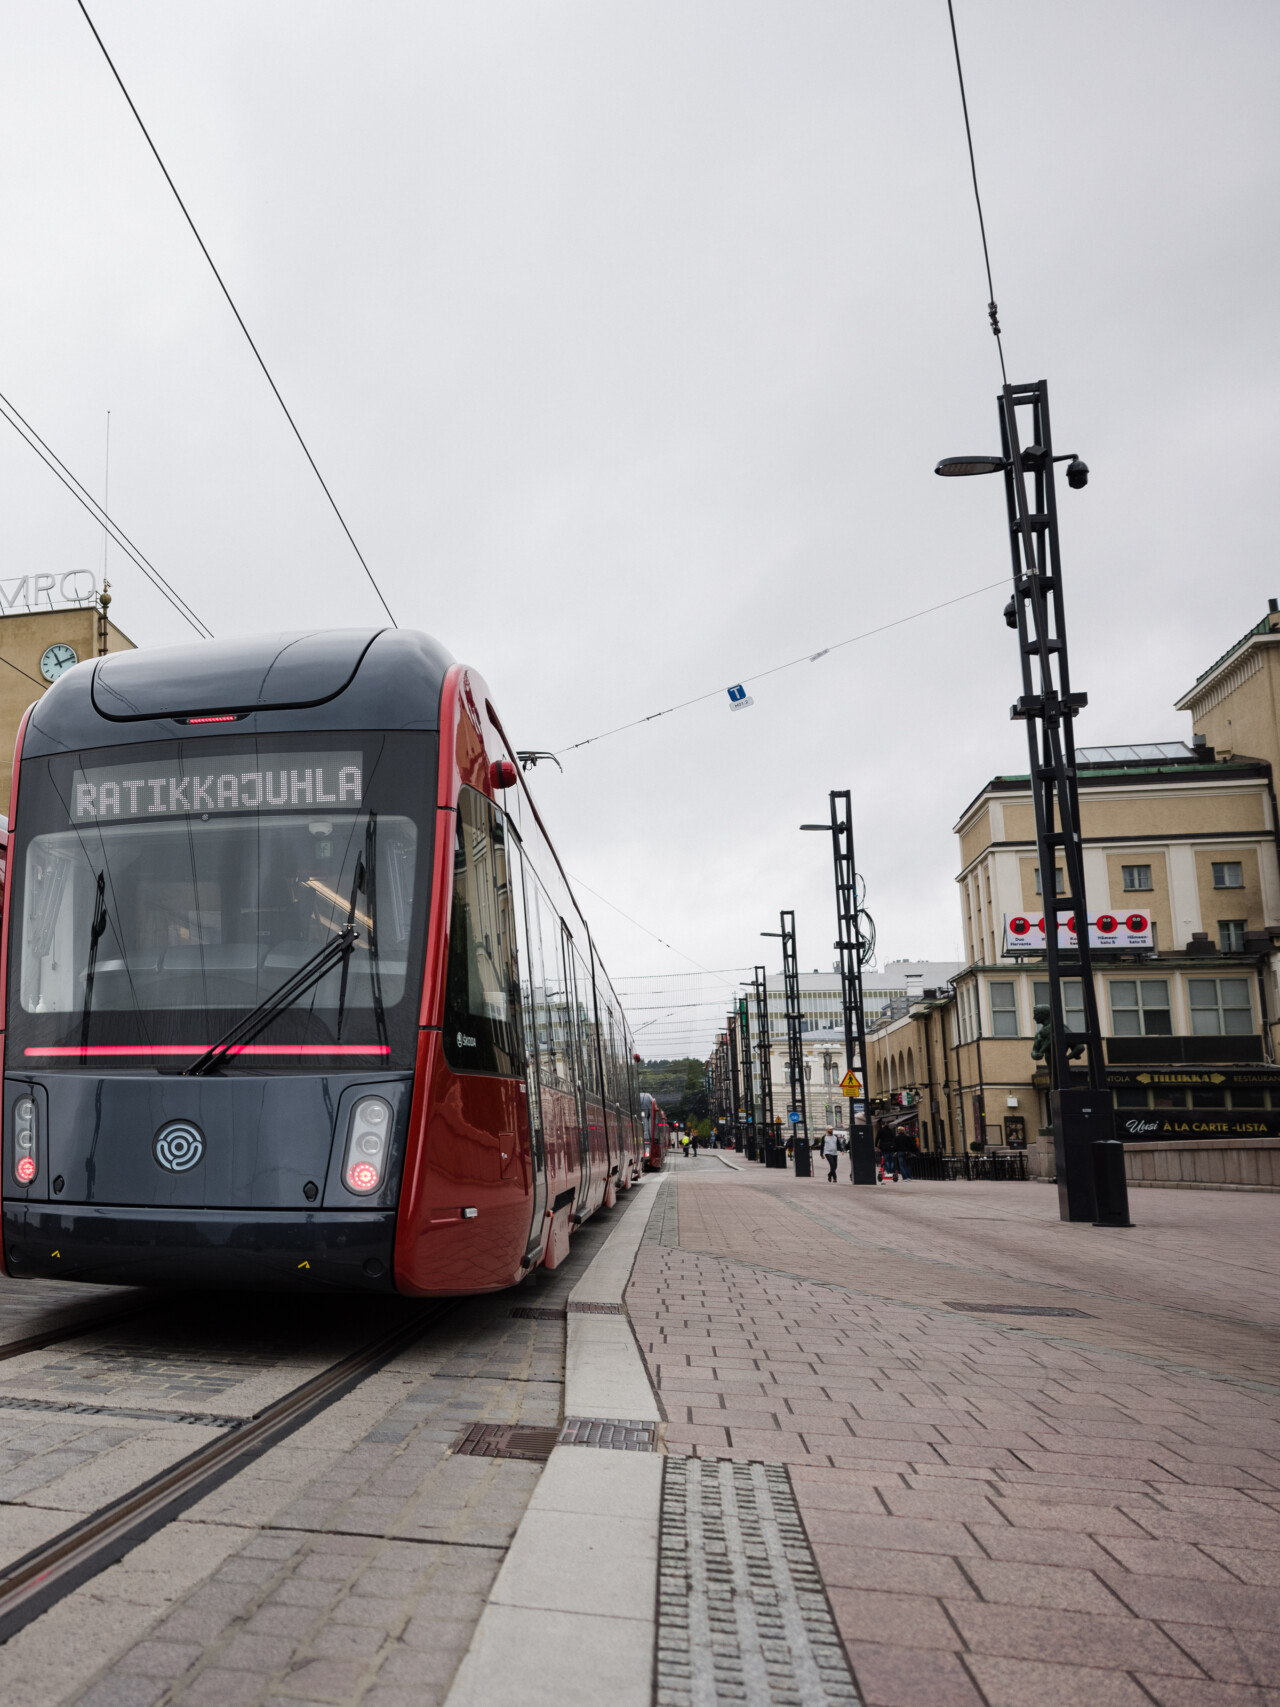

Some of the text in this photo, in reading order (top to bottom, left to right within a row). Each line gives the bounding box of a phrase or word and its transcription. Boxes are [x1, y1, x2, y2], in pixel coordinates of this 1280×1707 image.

[730, 686, 740, 699] T
[76, 766, 362, 816] RATIKKAJUHLA
[1153, 1074, 1210, 1083] TILLIKKA
[1125, 1119, 1159, 1134] Uusi
[1163, 1120, 1171, 1132] À
[1175, 1122, 1189, 1132] LA
[1192, 1122, 1229, 1132] CARTE
